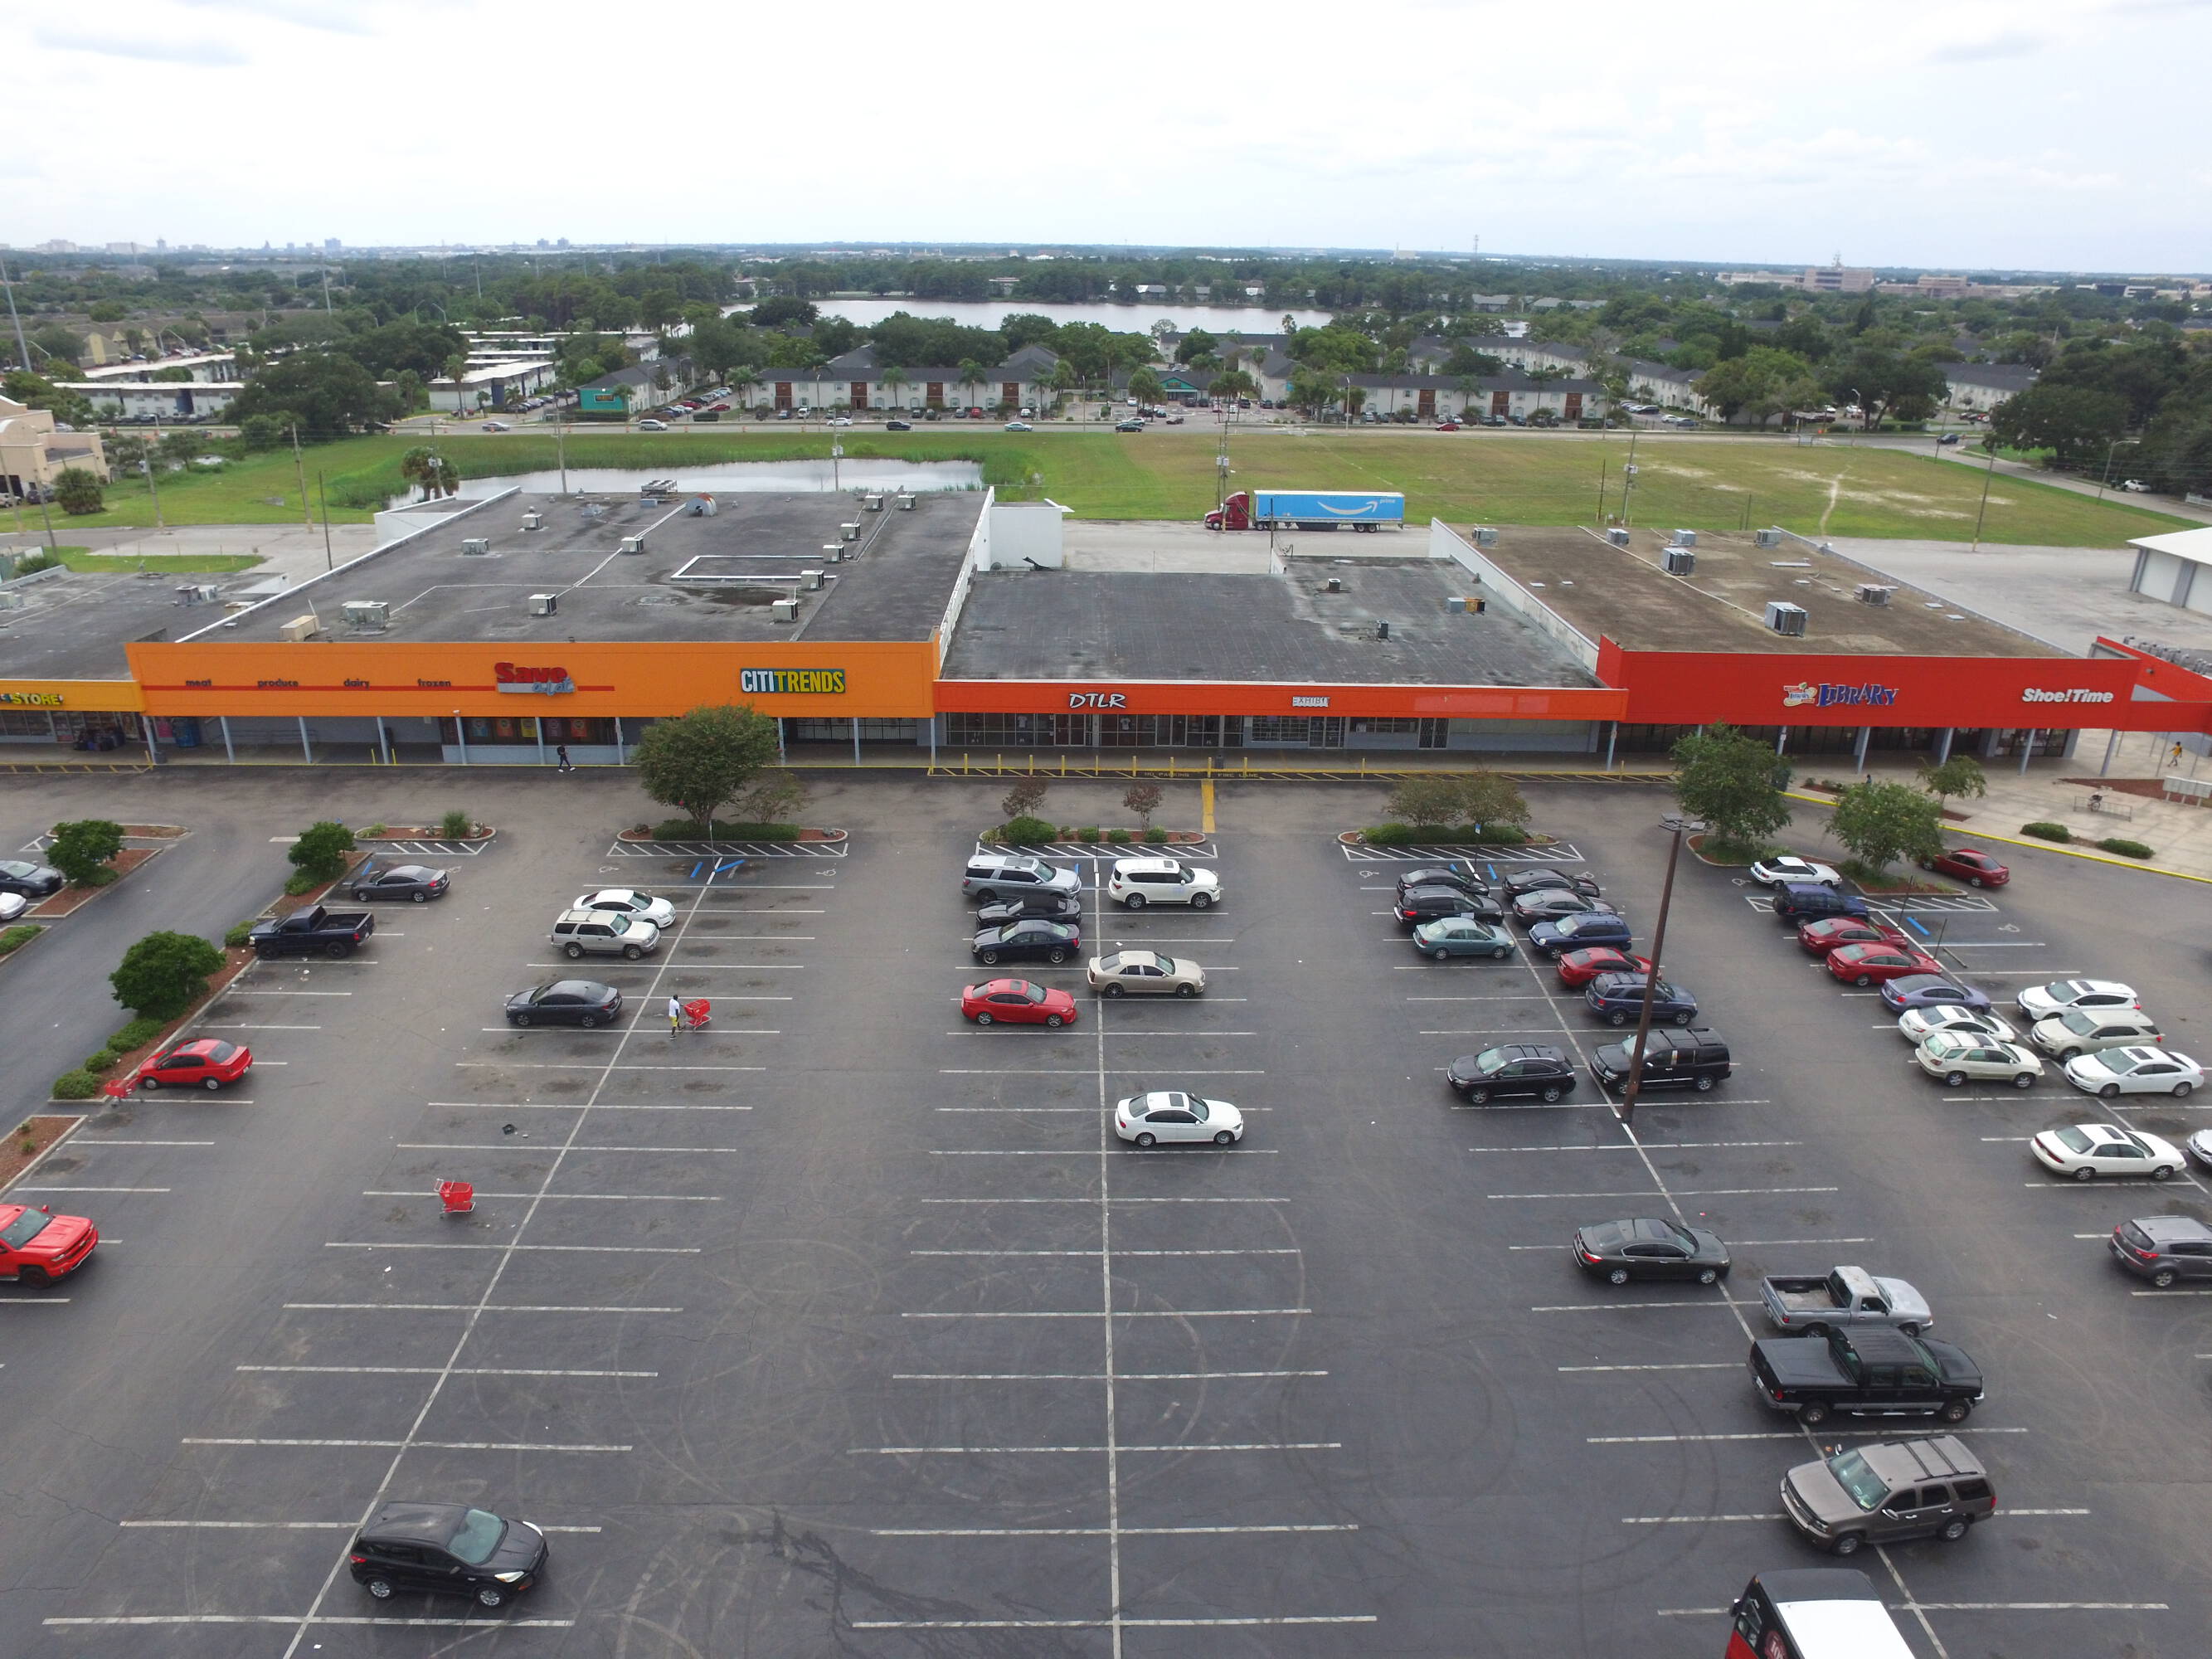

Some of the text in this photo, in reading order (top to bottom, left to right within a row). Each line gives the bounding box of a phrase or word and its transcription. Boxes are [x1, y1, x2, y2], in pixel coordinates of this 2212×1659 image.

[494, 662, 567, 683] Save
[185, 678, 452, 690] meat produce dairy frozen
[12, 692, 61, 705] STORE
[1069, 693, 1126, 708] DTLR
[1816, 683, 1899, 707] LIBRARY
[2022, 688, 2114, 703] Shoe!Time
